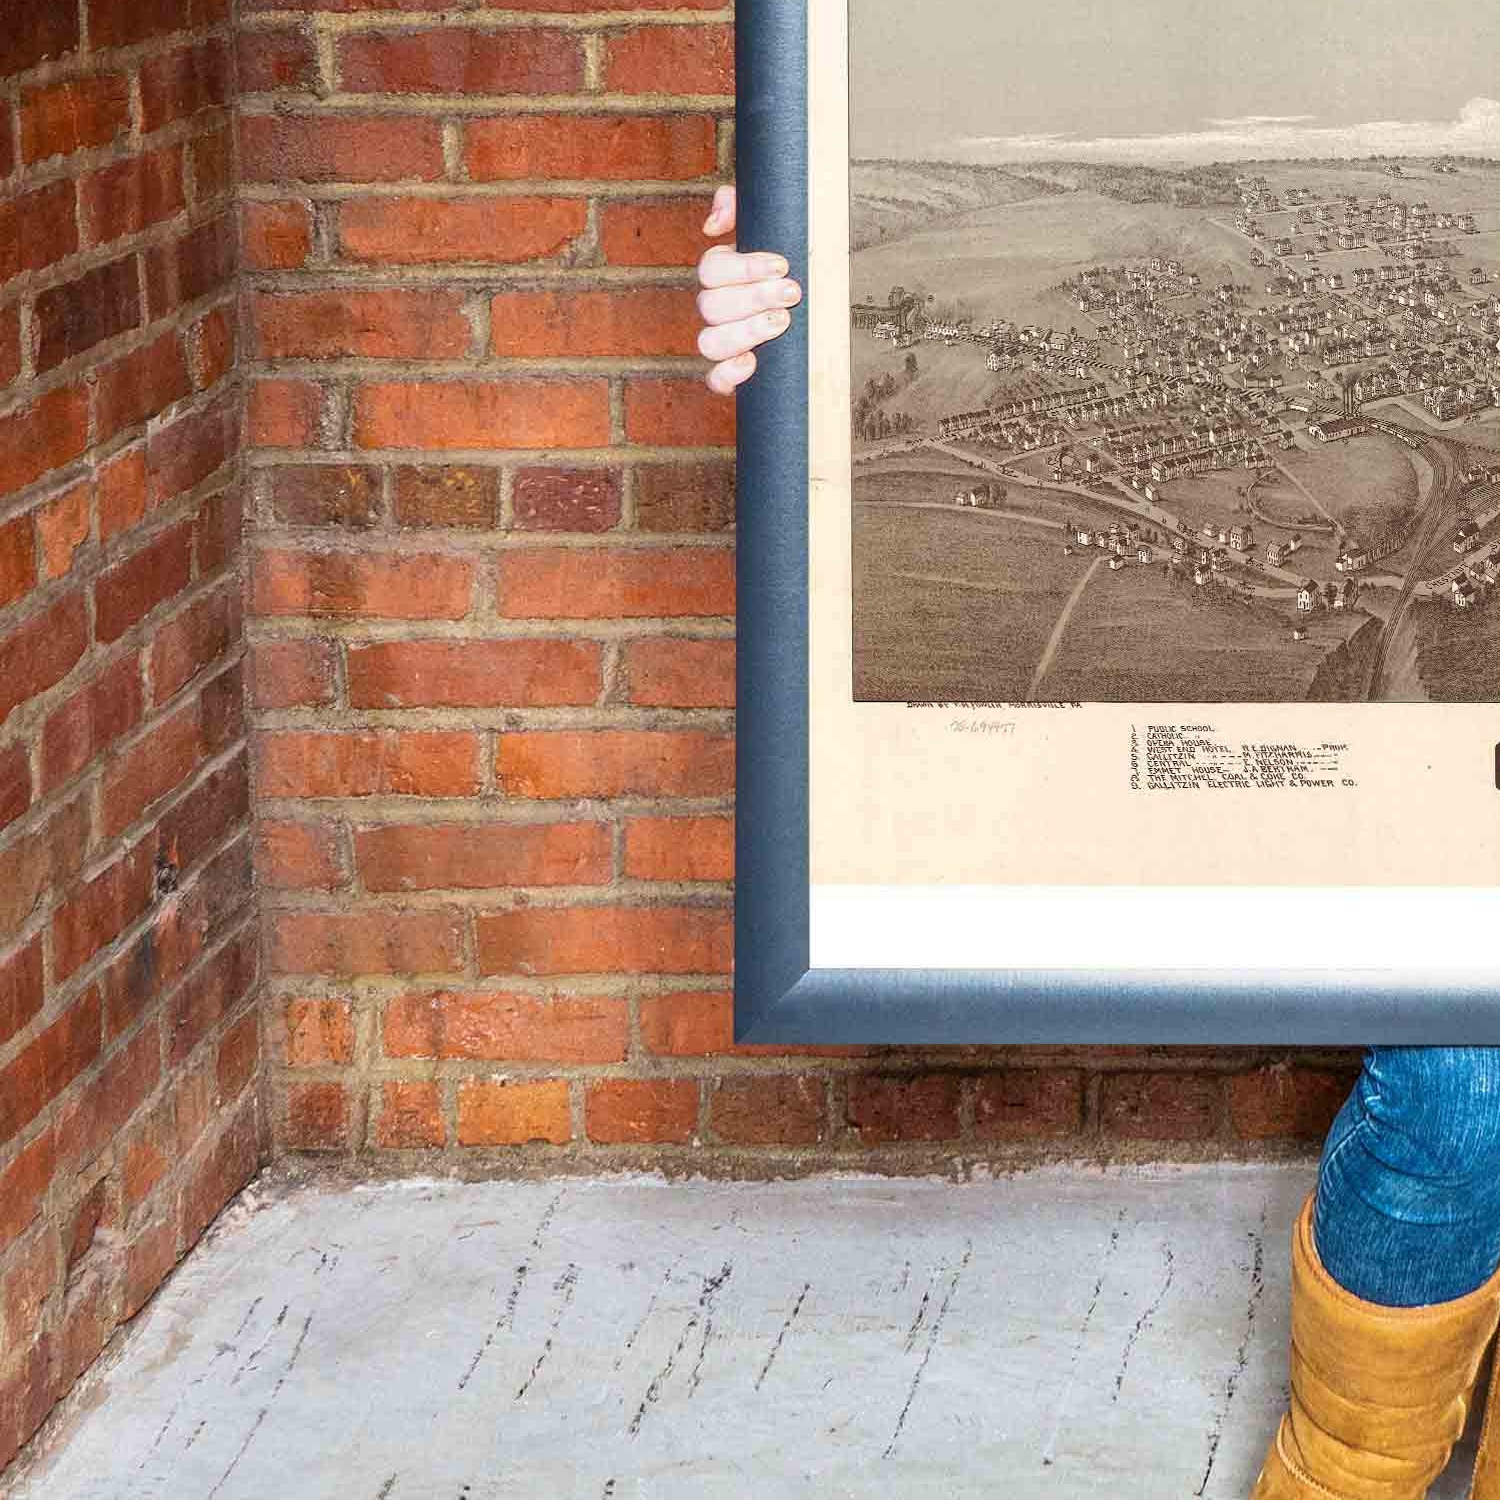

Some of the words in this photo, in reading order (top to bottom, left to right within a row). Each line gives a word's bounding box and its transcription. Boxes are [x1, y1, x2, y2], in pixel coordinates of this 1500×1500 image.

[1221, 773, 1248, 781] COAL
[1147, 781, 1201, 789] GALLITZIN
[1207, 780, 1251, 788] ELECTRIC
[1256, 780, 1285, 788] LIGHT
[1299, 779, 1335, 788] POWER
